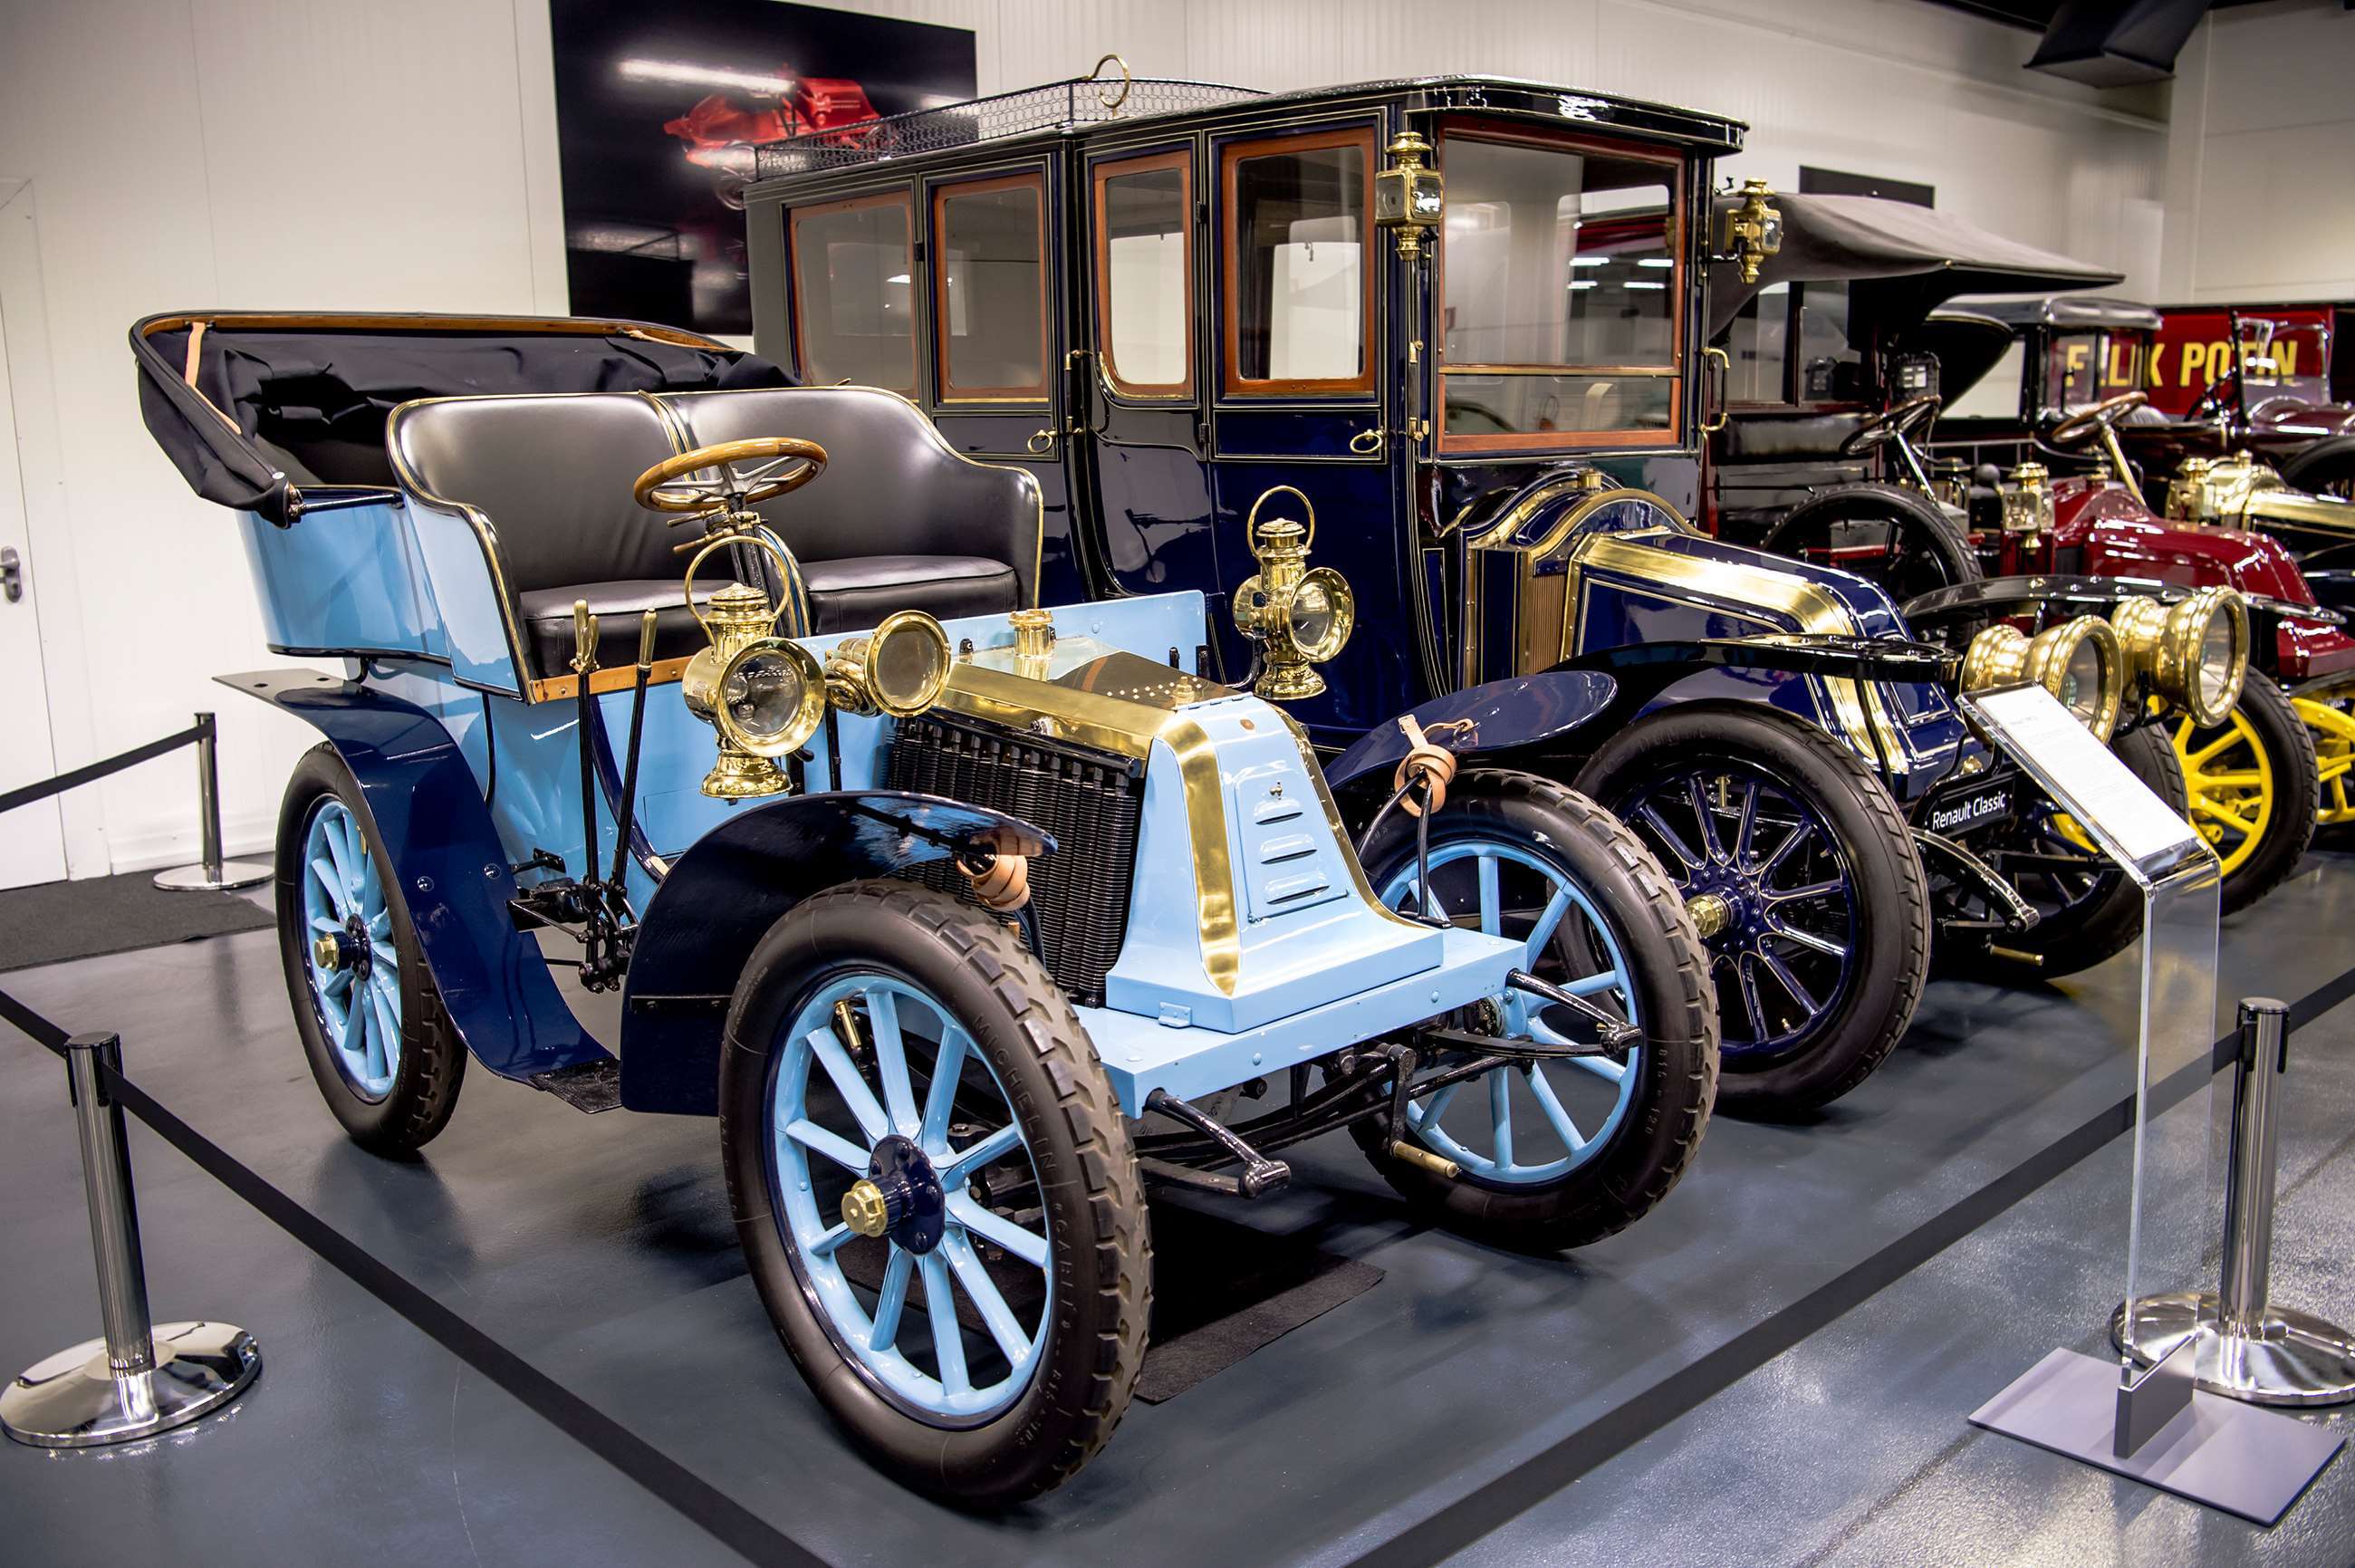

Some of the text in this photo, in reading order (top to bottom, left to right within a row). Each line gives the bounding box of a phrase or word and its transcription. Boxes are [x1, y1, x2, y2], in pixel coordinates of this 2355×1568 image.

[2065, 343, 2166, 387] FLIX
[1932, 791, 2005, 831] Renault Classic
[973, 1014, 1057, 1169] MICHELIN
